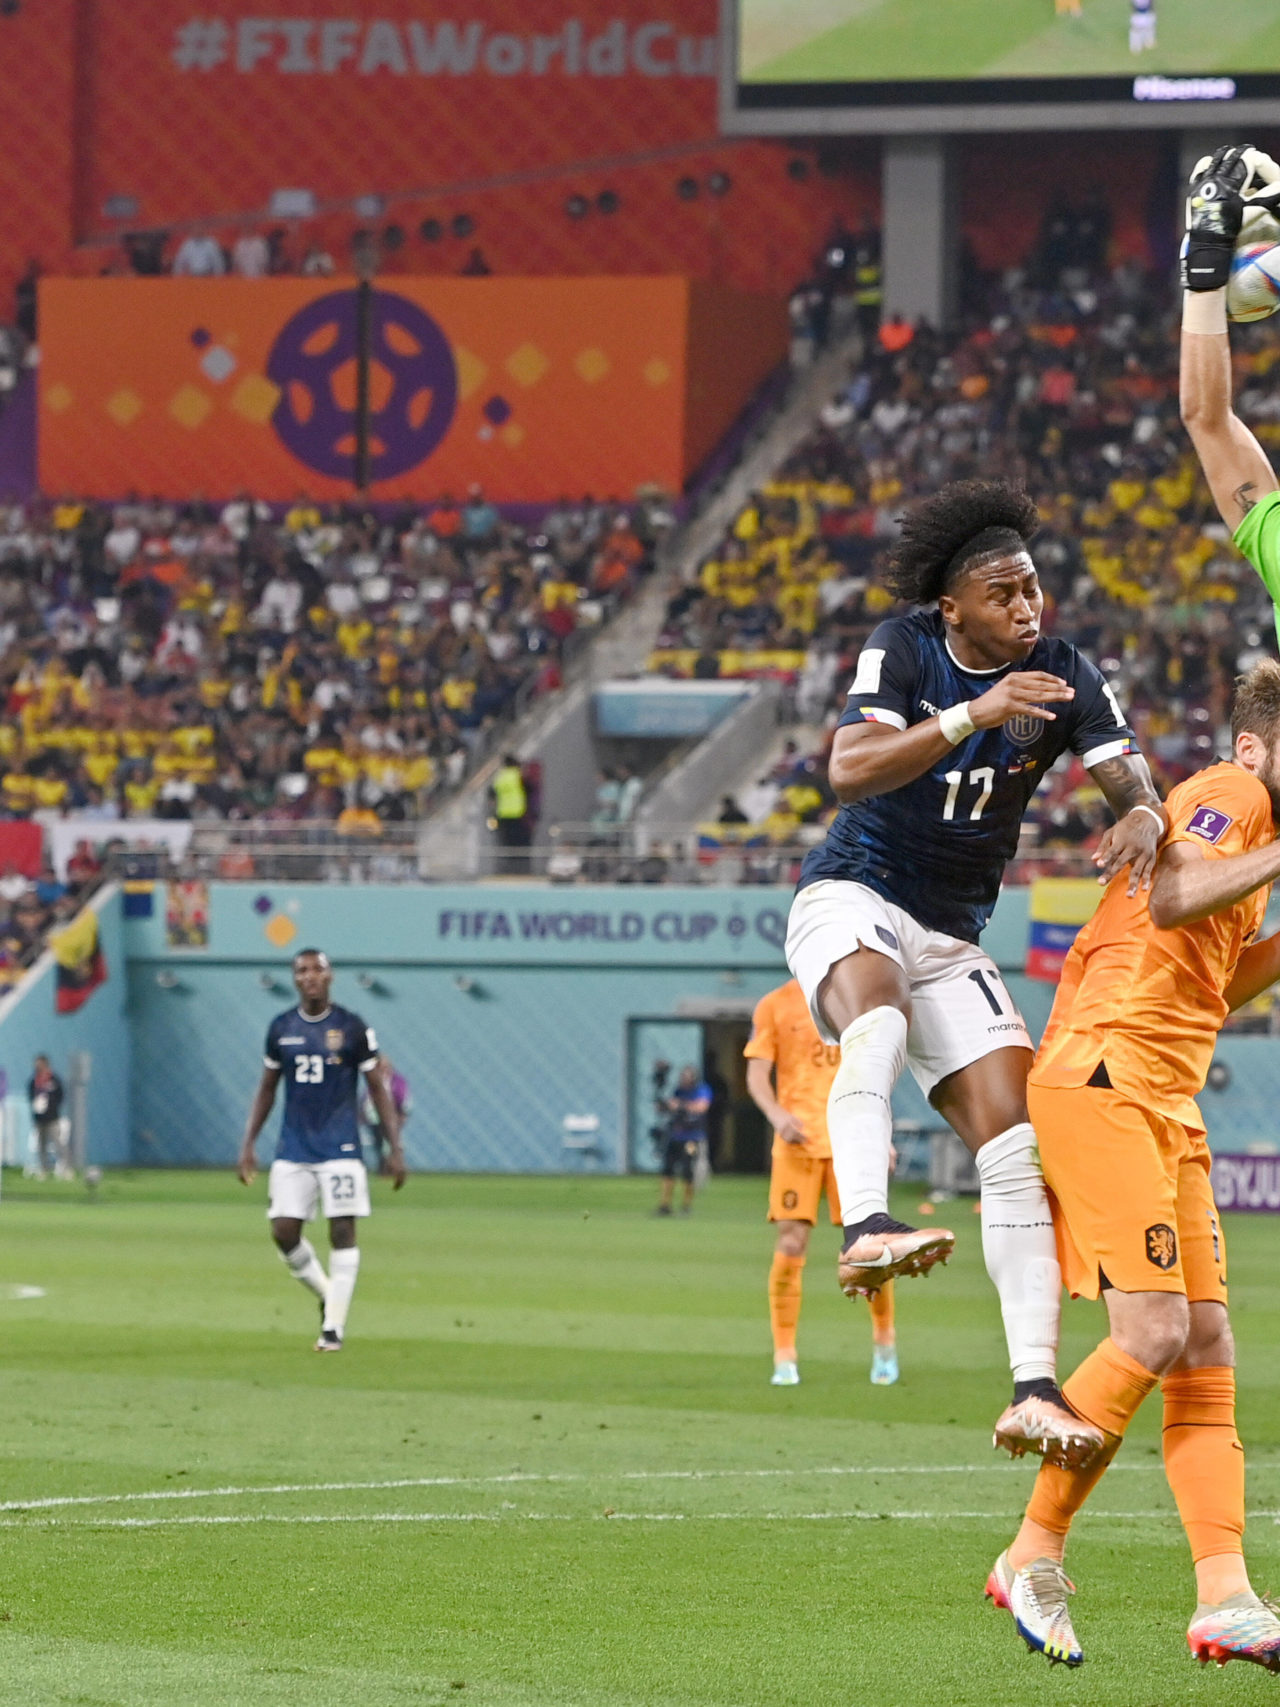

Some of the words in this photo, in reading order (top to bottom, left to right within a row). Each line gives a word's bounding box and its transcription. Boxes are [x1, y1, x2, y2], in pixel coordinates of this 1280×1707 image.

[173, 18, 719, 76] #FIFAWorldCu
[943, 767, 995, 820] 17
[438, 910, 512, 940] FIFA
[518, 911, 645, 942] WORLD
[652, 911, 718, 942] CUP
[294, 1054, 325, 1084] 23
[330, 1175, 355, 1200] 23
